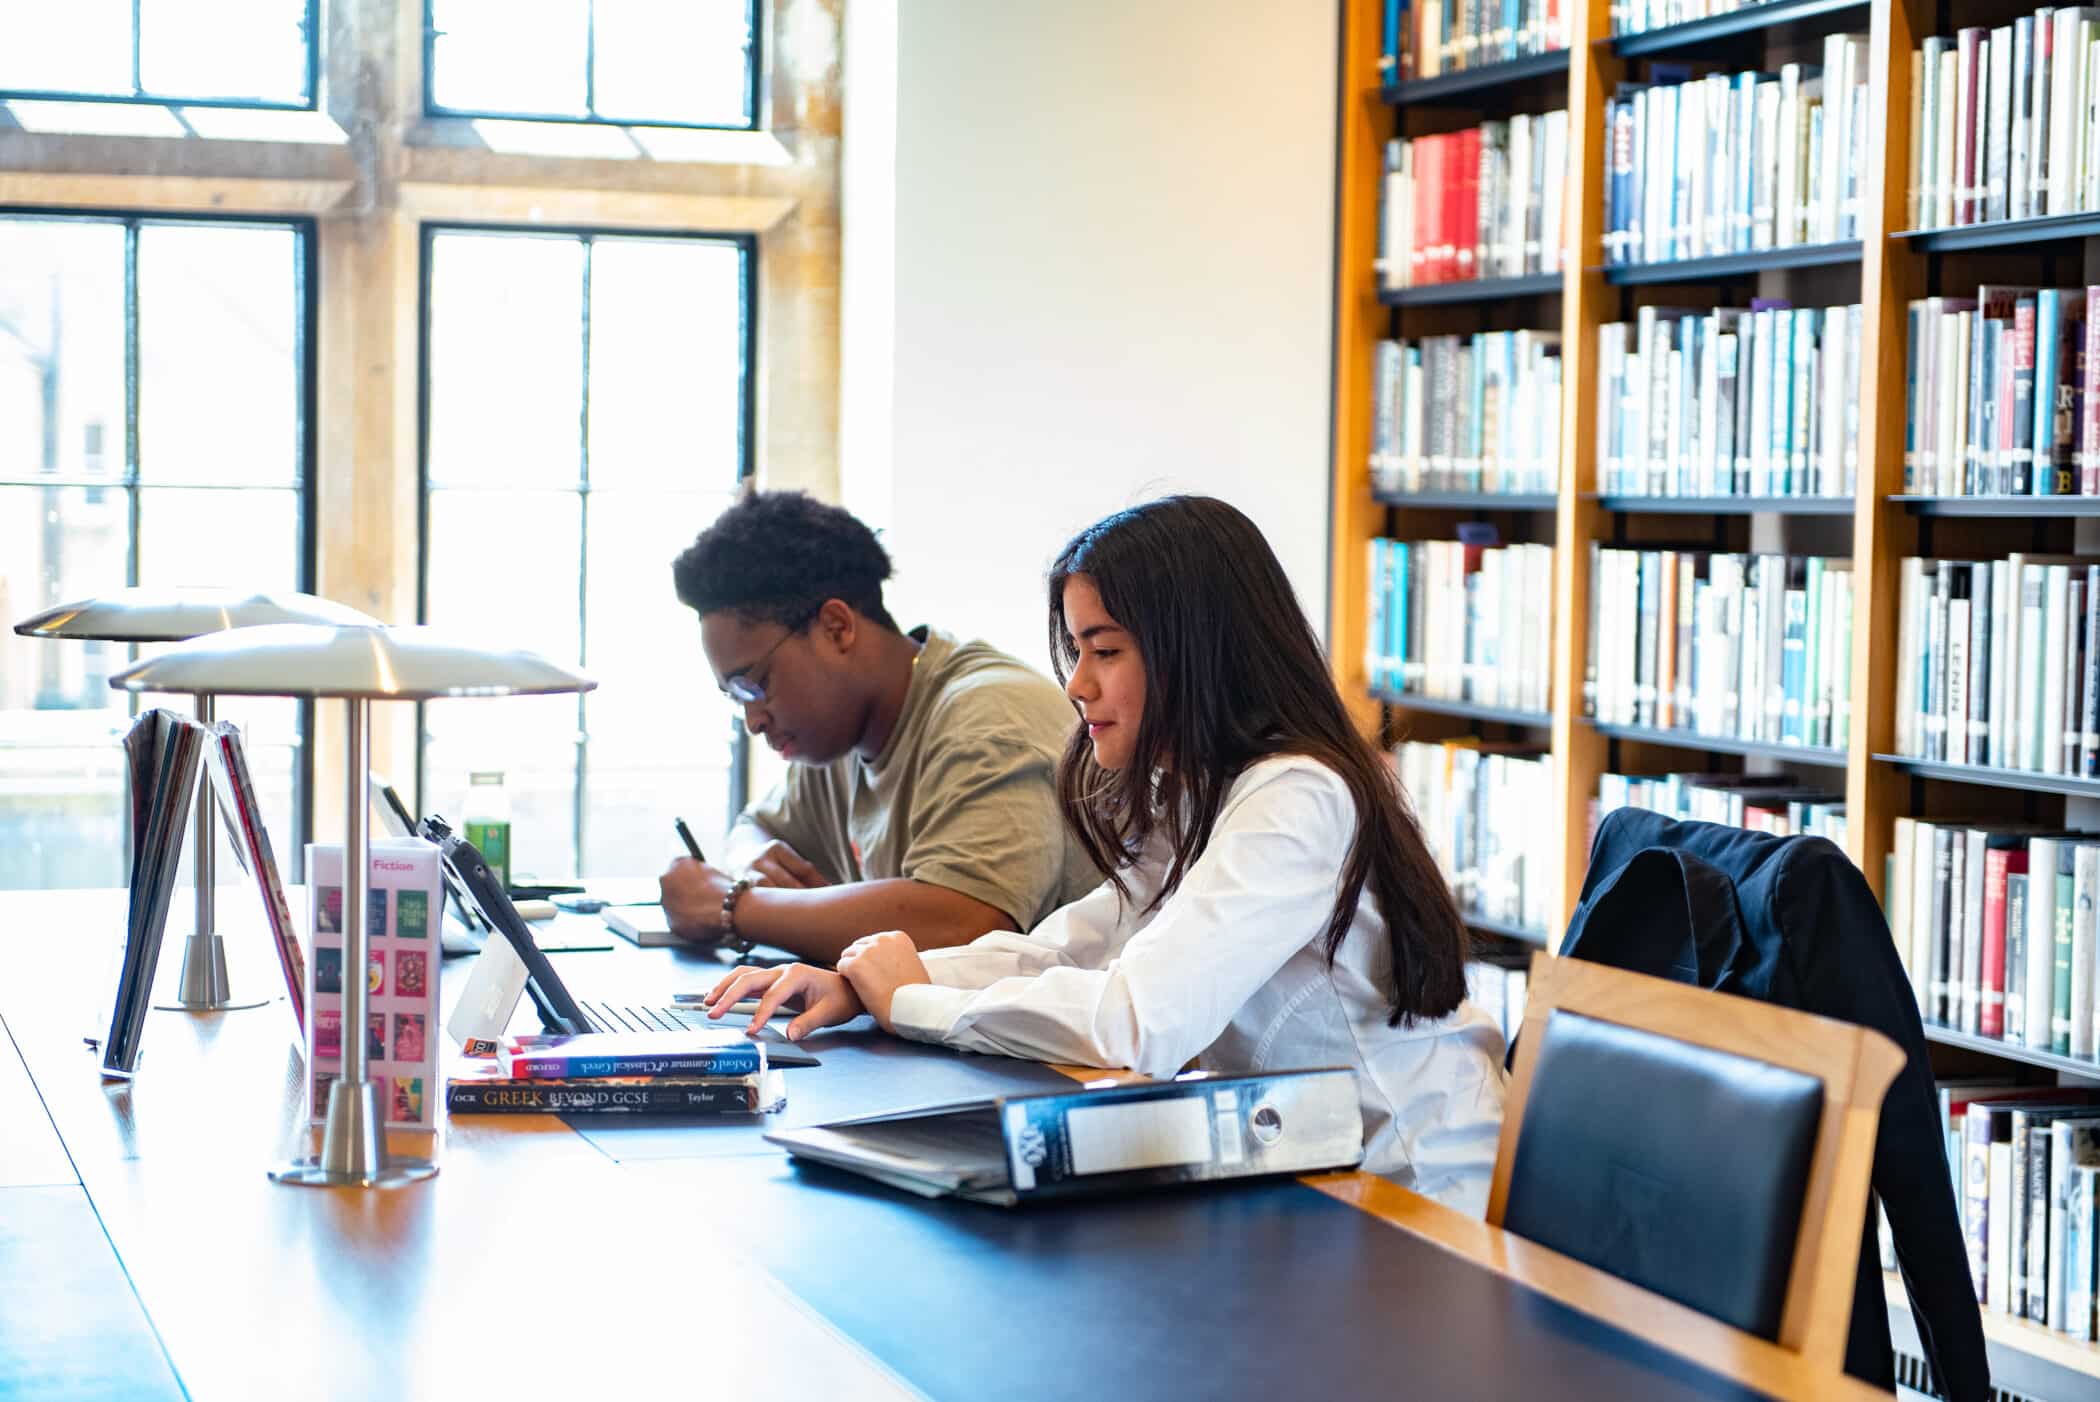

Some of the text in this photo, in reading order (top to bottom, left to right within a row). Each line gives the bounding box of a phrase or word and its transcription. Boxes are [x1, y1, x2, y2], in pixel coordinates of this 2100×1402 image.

[373, 860, 415, 872] Fiction
[581, 1058, 753, 1074] Oxford Grammar of Classical Greek
[484, 1090, 544, 1106] GREEK
[550, 1092, 609, 1105] BEYOND
[612, 1092, 649, 1104] GCSE
[687, 1093, 714, 1104] Taylor
